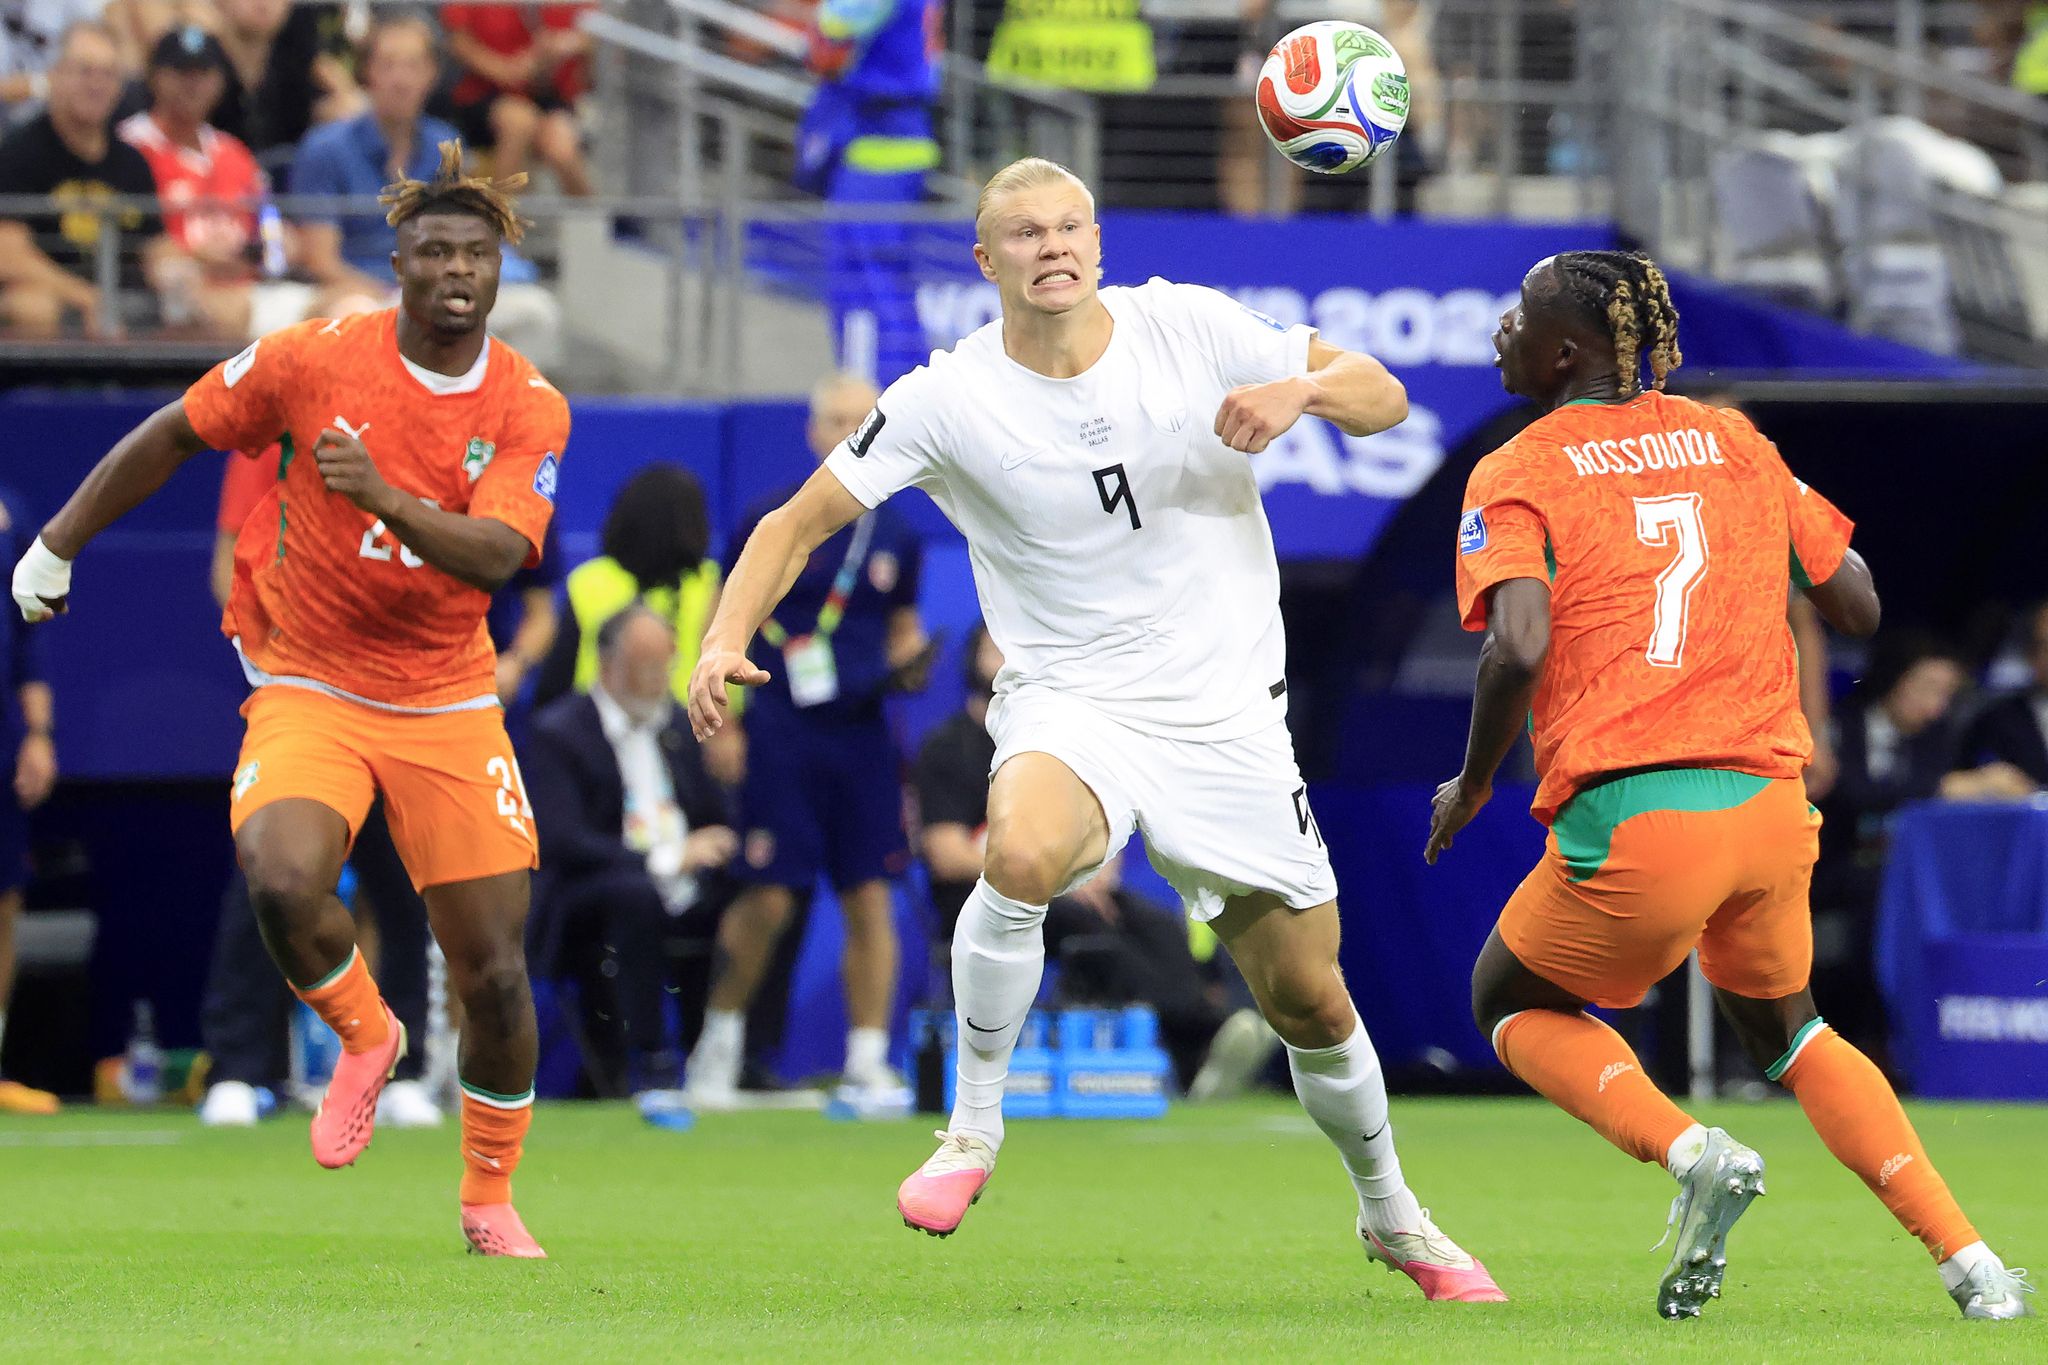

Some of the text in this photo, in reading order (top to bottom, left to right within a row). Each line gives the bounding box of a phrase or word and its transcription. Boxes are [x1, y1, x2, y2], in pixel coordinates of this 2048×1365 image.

[1311, 286, 1521, 366] 202
[1092, 463, 1142, 531] 9
[1632, 492, 1709, 668] 7
